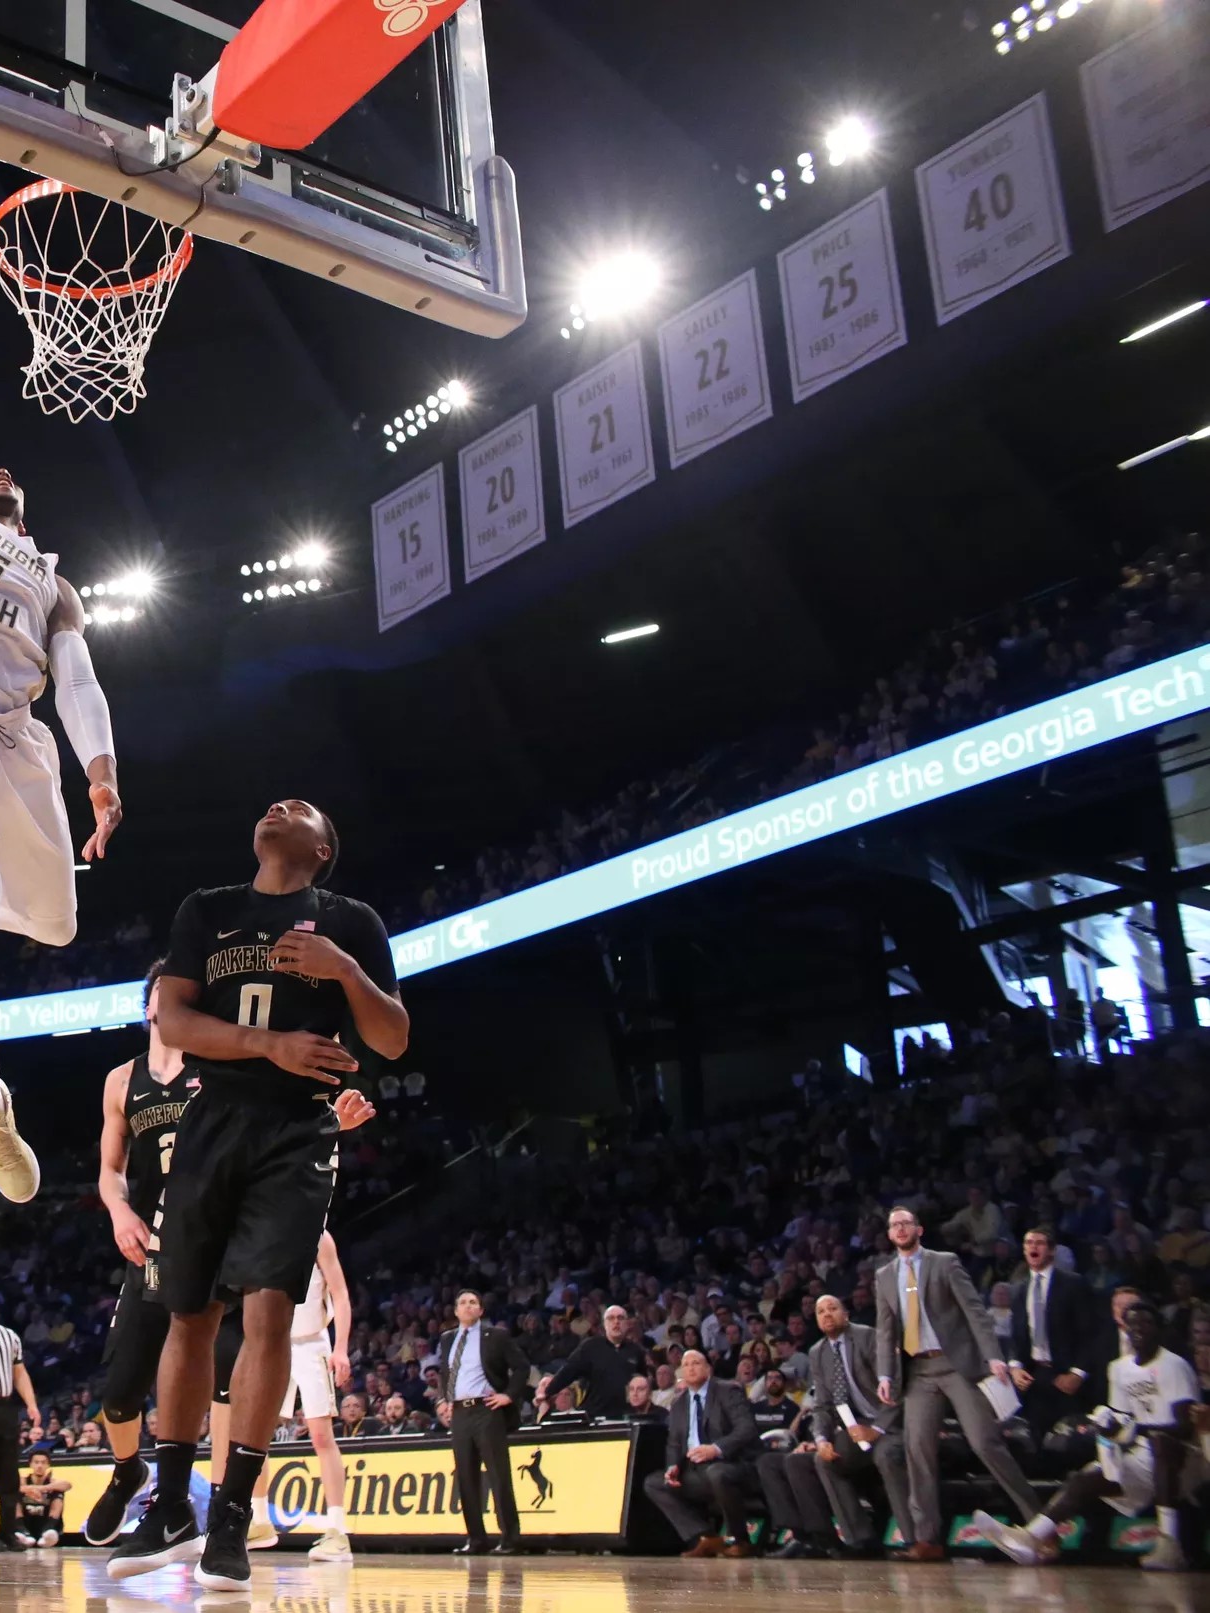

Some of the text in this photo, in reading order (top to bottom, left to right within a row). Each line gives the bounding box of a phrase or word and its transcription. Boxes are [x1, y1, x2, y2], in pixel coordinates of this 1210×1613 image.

[963, 172, 1015, 233] 40
[811, 228, 852, 265] PRICE
[818, 261, 859, 320] 25
[694, 338, 730, 391] 22
[588, 404, 616, 454] 21
[485, 465, 516, 515] 20
[397, 520, 422, 565] 15
[631, 664, 1205, 889] Proud Sponsor of the Georgia Tech
[206, 945, 255, 985] WAKE
[395, 934, 437, 967] AT&T
[26, 1000, 100, 1028] Yellow
[237, 982, 273, 1031] 0
[129, 1103, 164, 1138] WAKE
